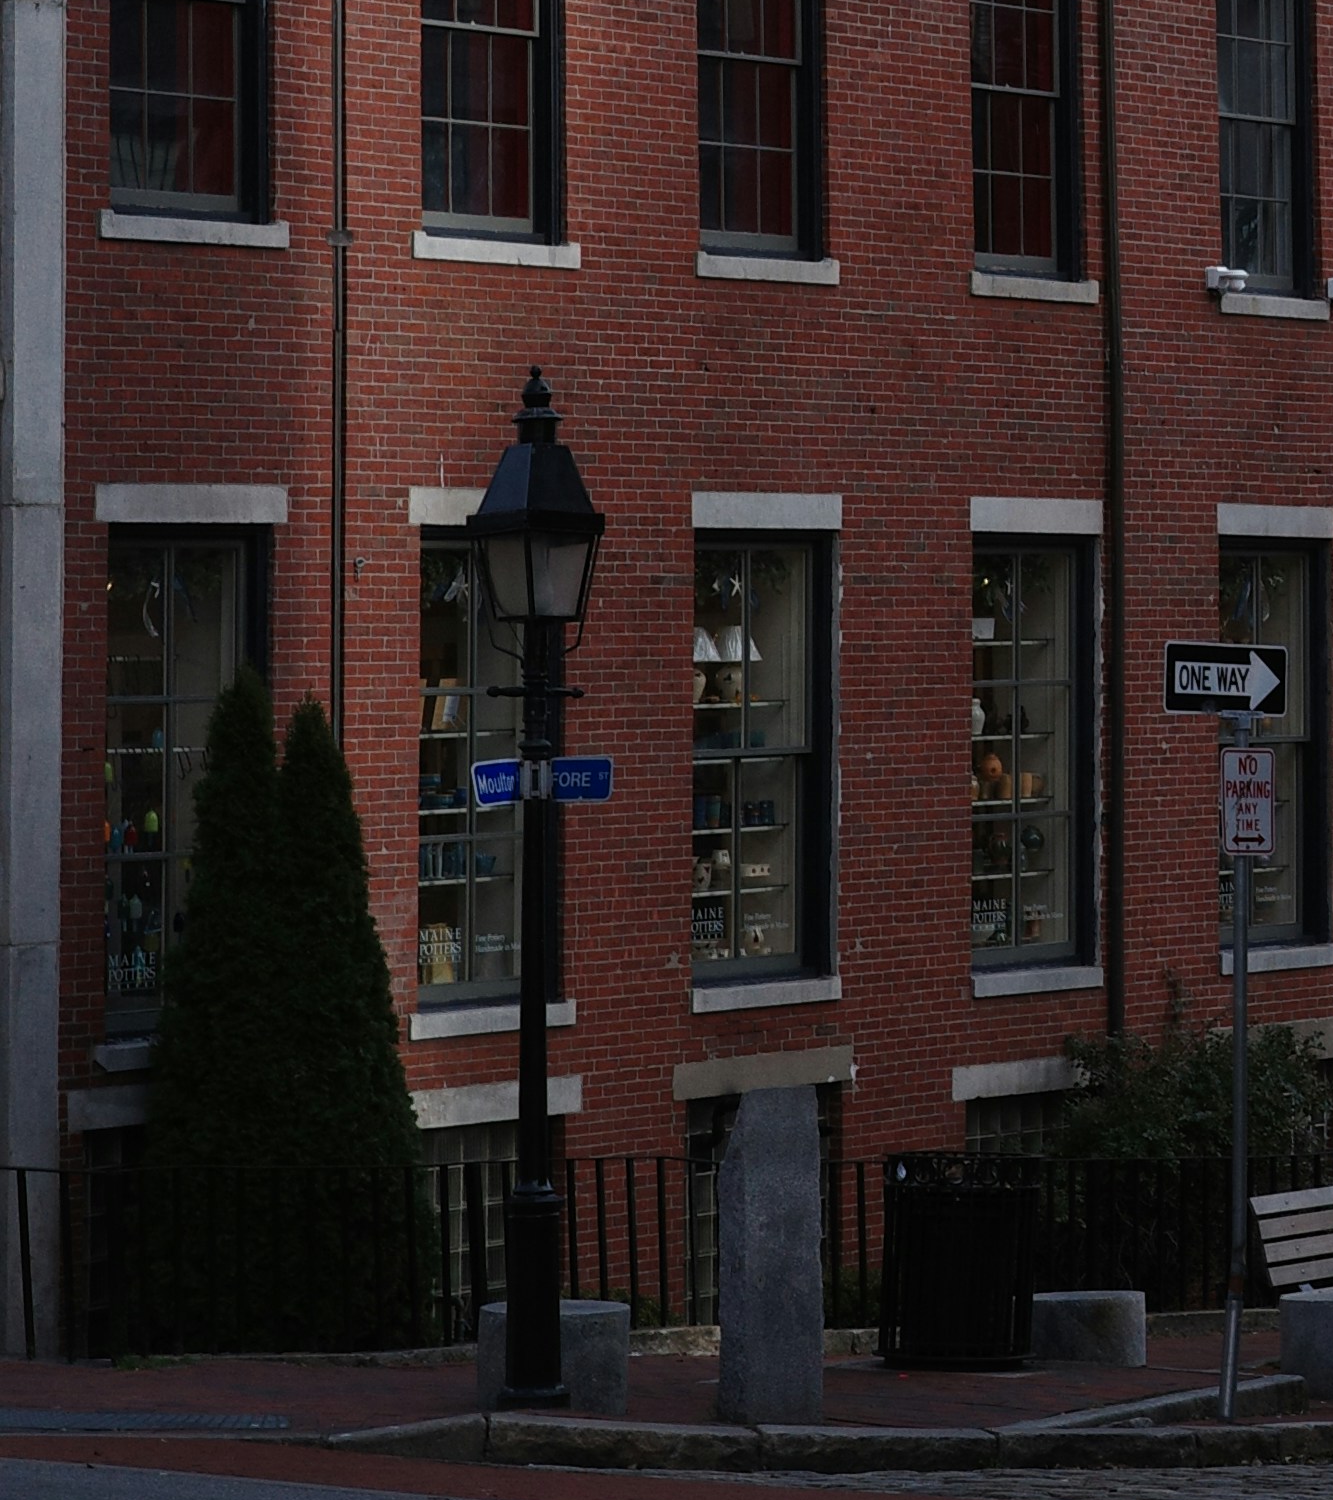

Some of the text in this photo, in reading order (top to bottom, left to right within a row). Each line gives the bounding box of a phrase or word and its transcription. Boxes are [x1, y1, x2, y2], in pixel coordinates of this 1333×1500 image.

[1178, 664, 1249, 693] ONE WAY
[1238, 757, 1258, 776] NO
[476, 771, 515, 795] Moulton
[551, 771, 610, 788] FORE ST
[1225, 780, 1271, 800] PARKING
[1236, 802, 1258, 816] ANY
[1235, 818, 1260, 832] TIME
[972, 898, 1006, 911] MAINE
[972, 911, 1006, 924] POTTERS
[691, 920, 724, 933] OTTERS
[419, 927, 462, 942] MAINE
[419, 941, 462, 956] POTTERS
[108, 951, 156, 967] MAINE
[108, 967, 156, 983] POTTERS
